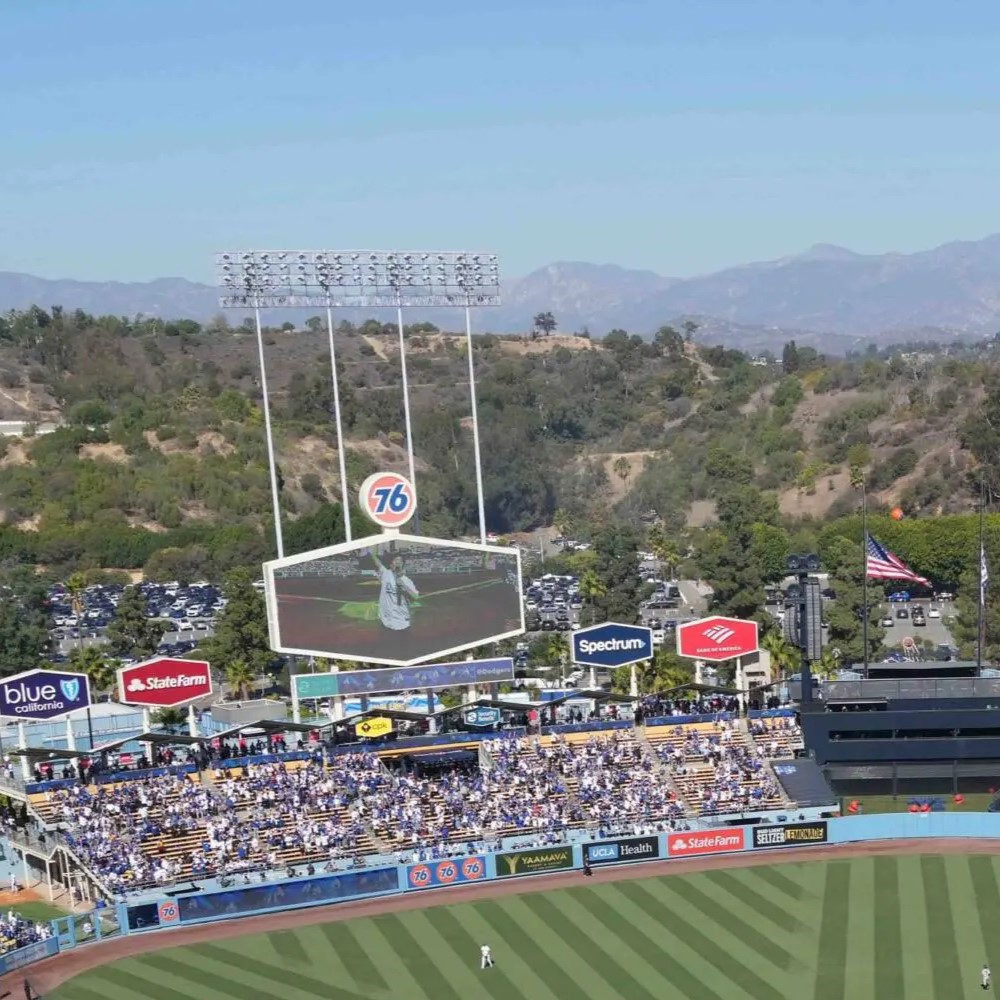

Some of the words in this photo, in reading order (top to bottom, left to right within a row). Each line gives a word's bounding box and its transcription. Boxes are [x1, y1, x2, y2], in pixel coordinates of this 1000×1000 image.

[373, 483, 409, 514] 76
[579, 637, 642, 655] Spectrum
[4, 683, 56, 704] blue
[15, 701, 64, 713] california
[757, 832, 785, 844] SELTZER
[592, 848, 615, 857] UCLA
[620, 842, 653, 856] Health
[440, 867, 453, 877] 76
[466, 864, 479, 874] 76
[414, 871, 427, 880] 76
[161, 908, 175, 916] 76
